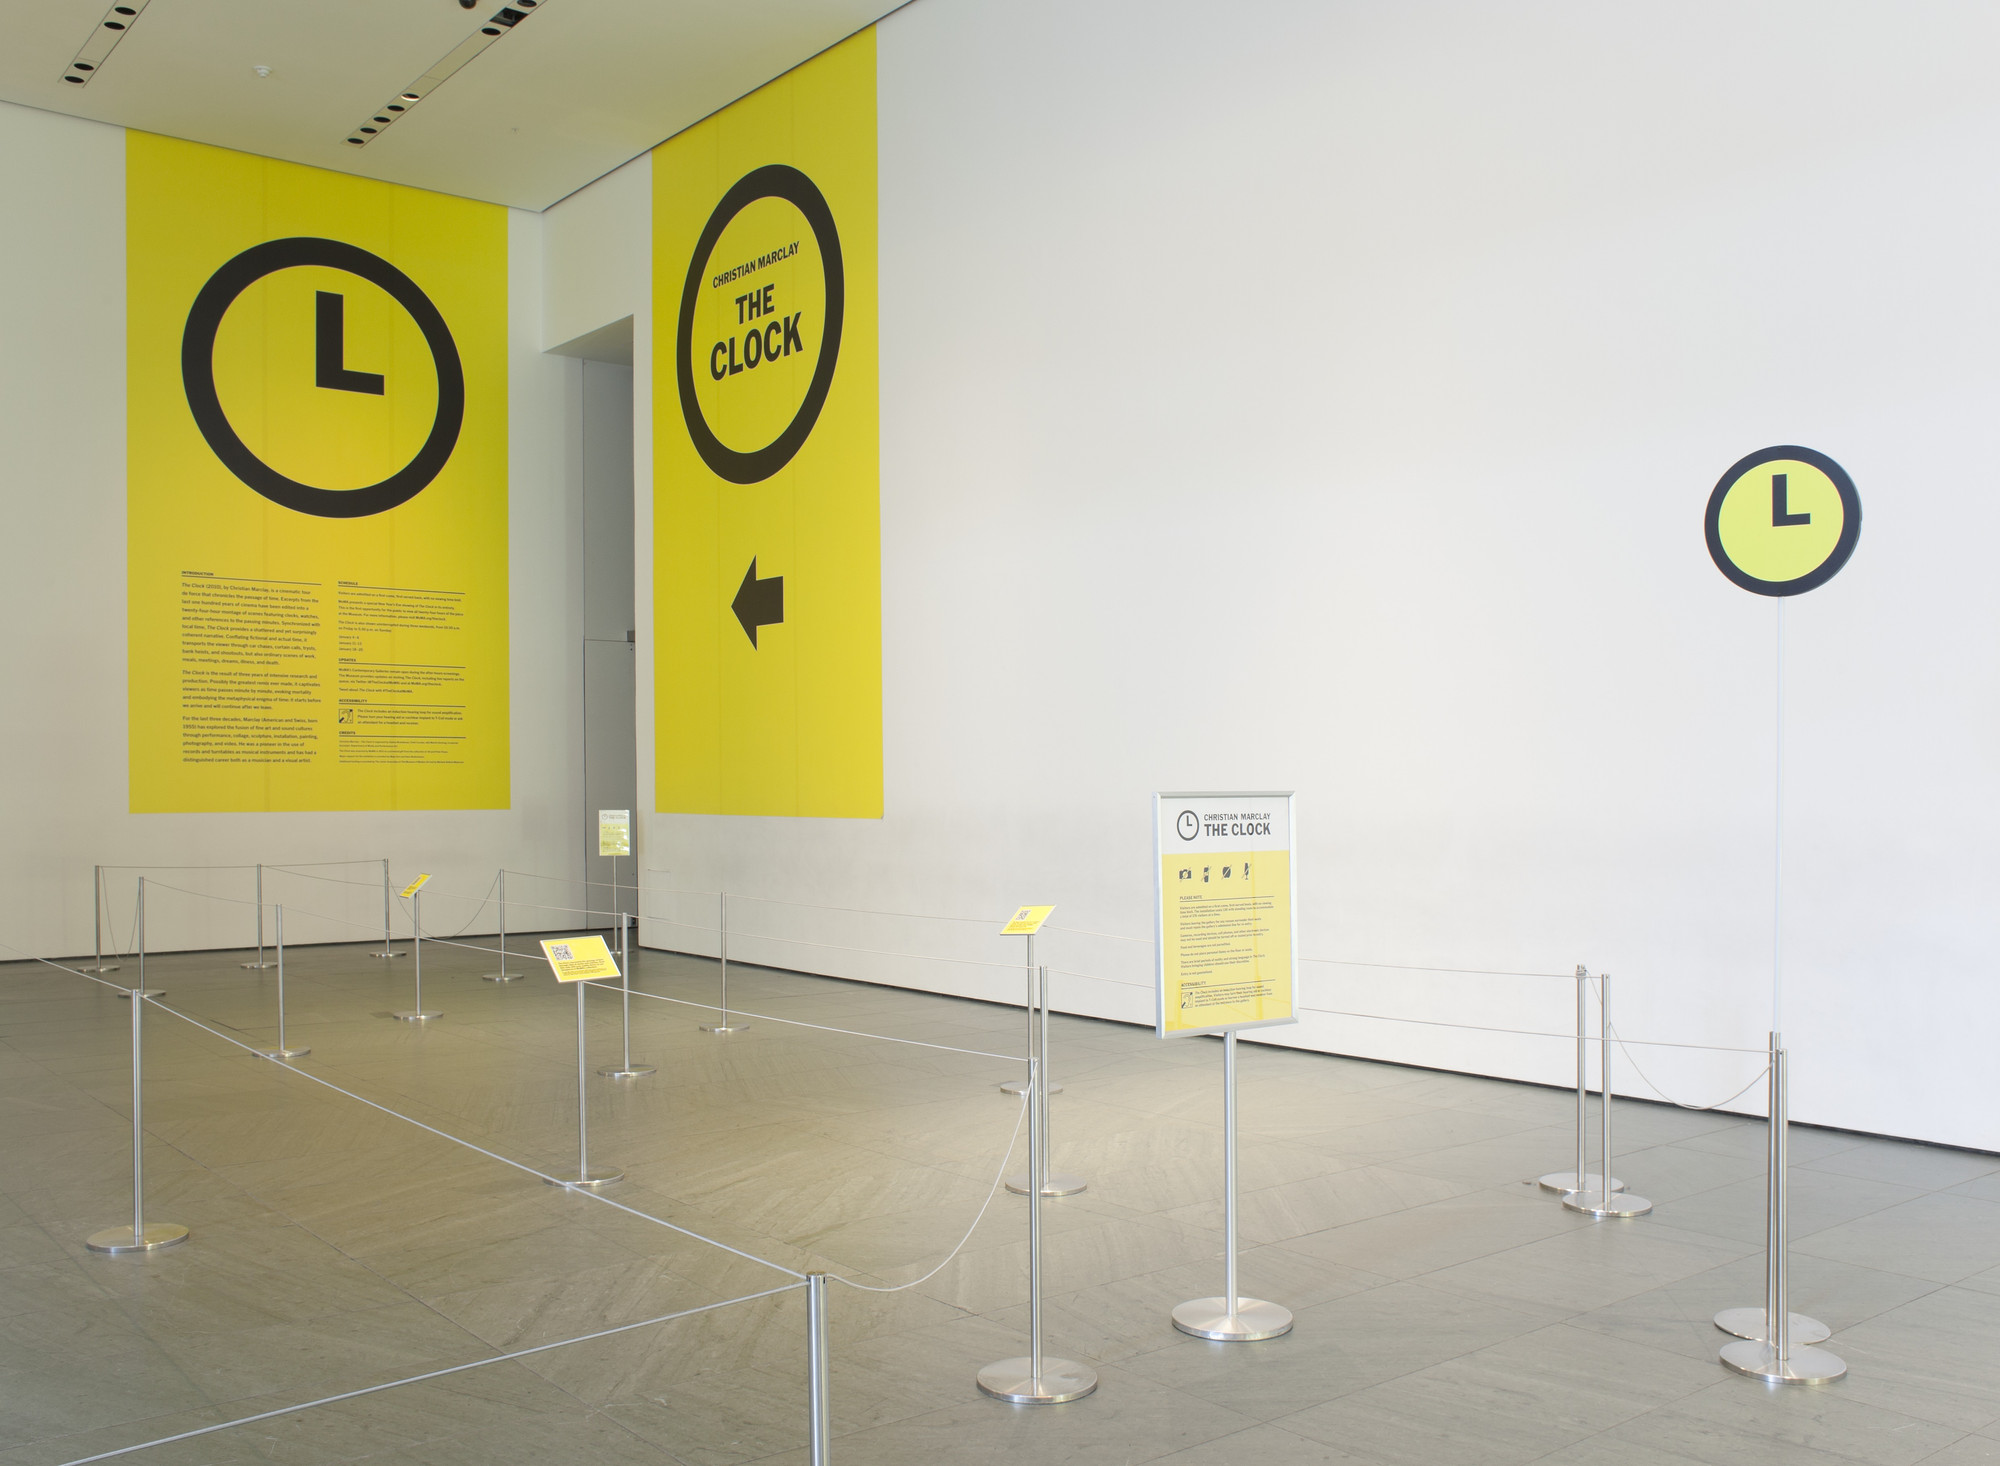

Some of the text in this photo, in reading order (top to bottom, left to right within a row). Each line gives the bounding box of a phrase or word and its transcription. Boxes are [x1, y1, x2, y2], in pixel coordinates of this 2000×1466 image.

[712, 241, 800, 289] CHRISTIAN MARCLAY
[735, 283, 775, 325] THE
[710, 311, 803, 381] CLOCK
[1204, 813, 1271, 821] CHRISTIAN MARCLAY
[1204, 822, 1271, 837] THE CLOCK
